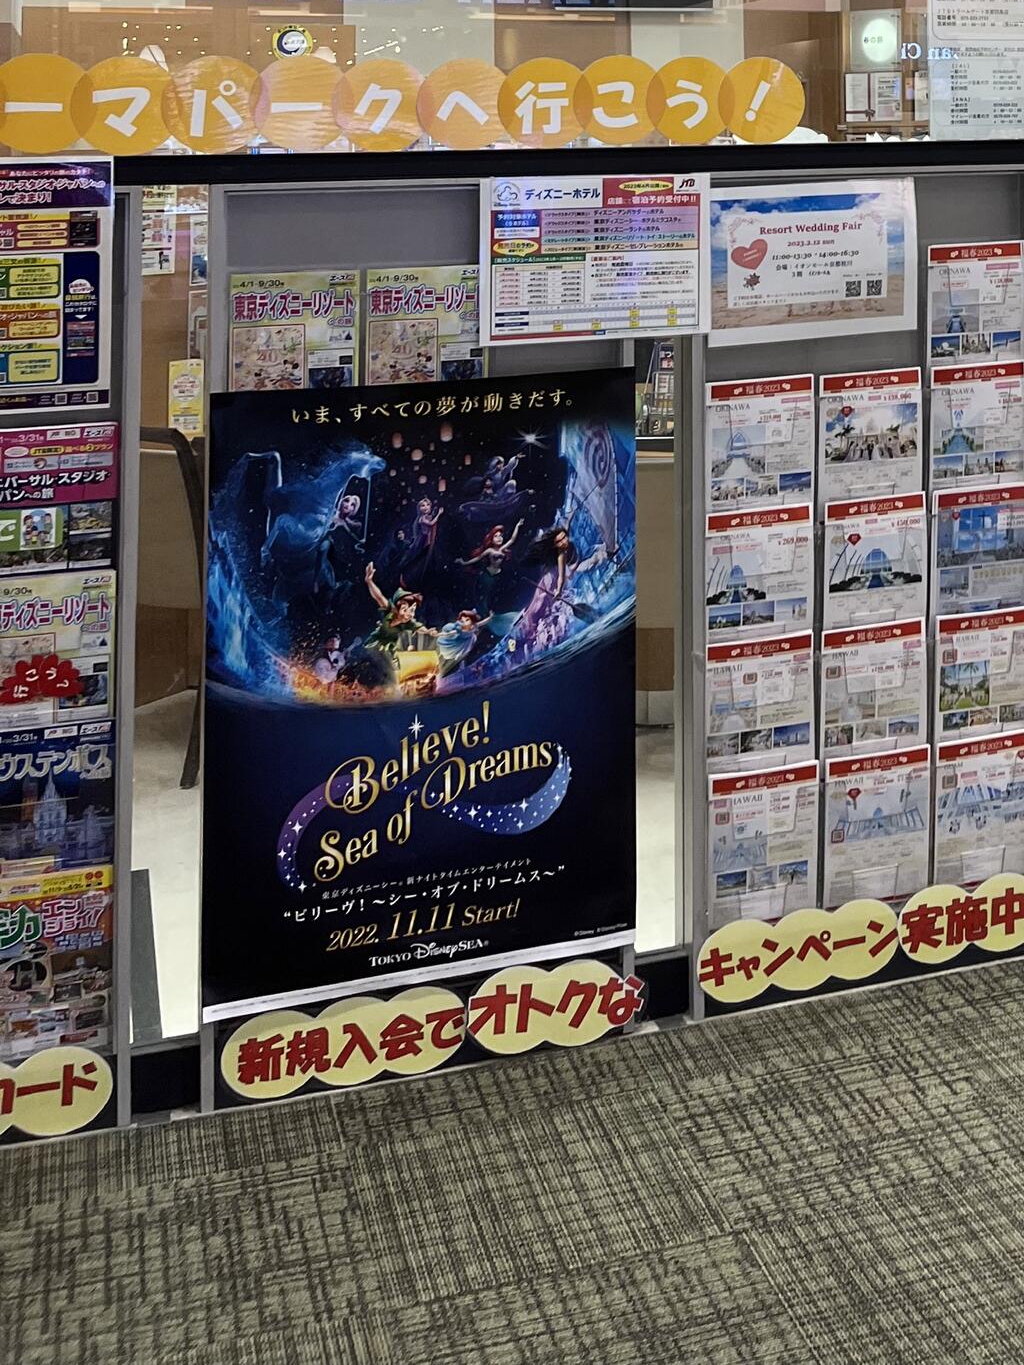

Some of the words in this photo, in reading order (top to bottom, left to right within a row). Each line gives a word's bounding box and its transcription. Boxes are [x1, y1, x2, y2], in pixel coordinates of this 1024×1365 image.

[525, 187, 600, 201] ディズニーホテル
[760, 225, 793, 235] Resort
[795, 223, 840, 234] Wedding
[842, 220, 863, 230] Fair
[231, 288, 356, 324] 東京ディズニーリゾート
[292, 388, 575, 426] いま、すべての夢が動きだす。
[0, 592, 112, 632] ディズニーリゾート
[325, 700, 490, 814] Believe!
[313, 828, 379, 883] Sea
[386, 788, 419, 846] of
[421, 739, 553, 810] Dreams
[326, 923, 380, 952] 2022.
[386, 902, 456, 941] 11.11
[460, 898, 521, 927] Start!
[368, 951, 412, 968] TOKYO
[235, 970, 647, 1084] 新規入会でオトクな
